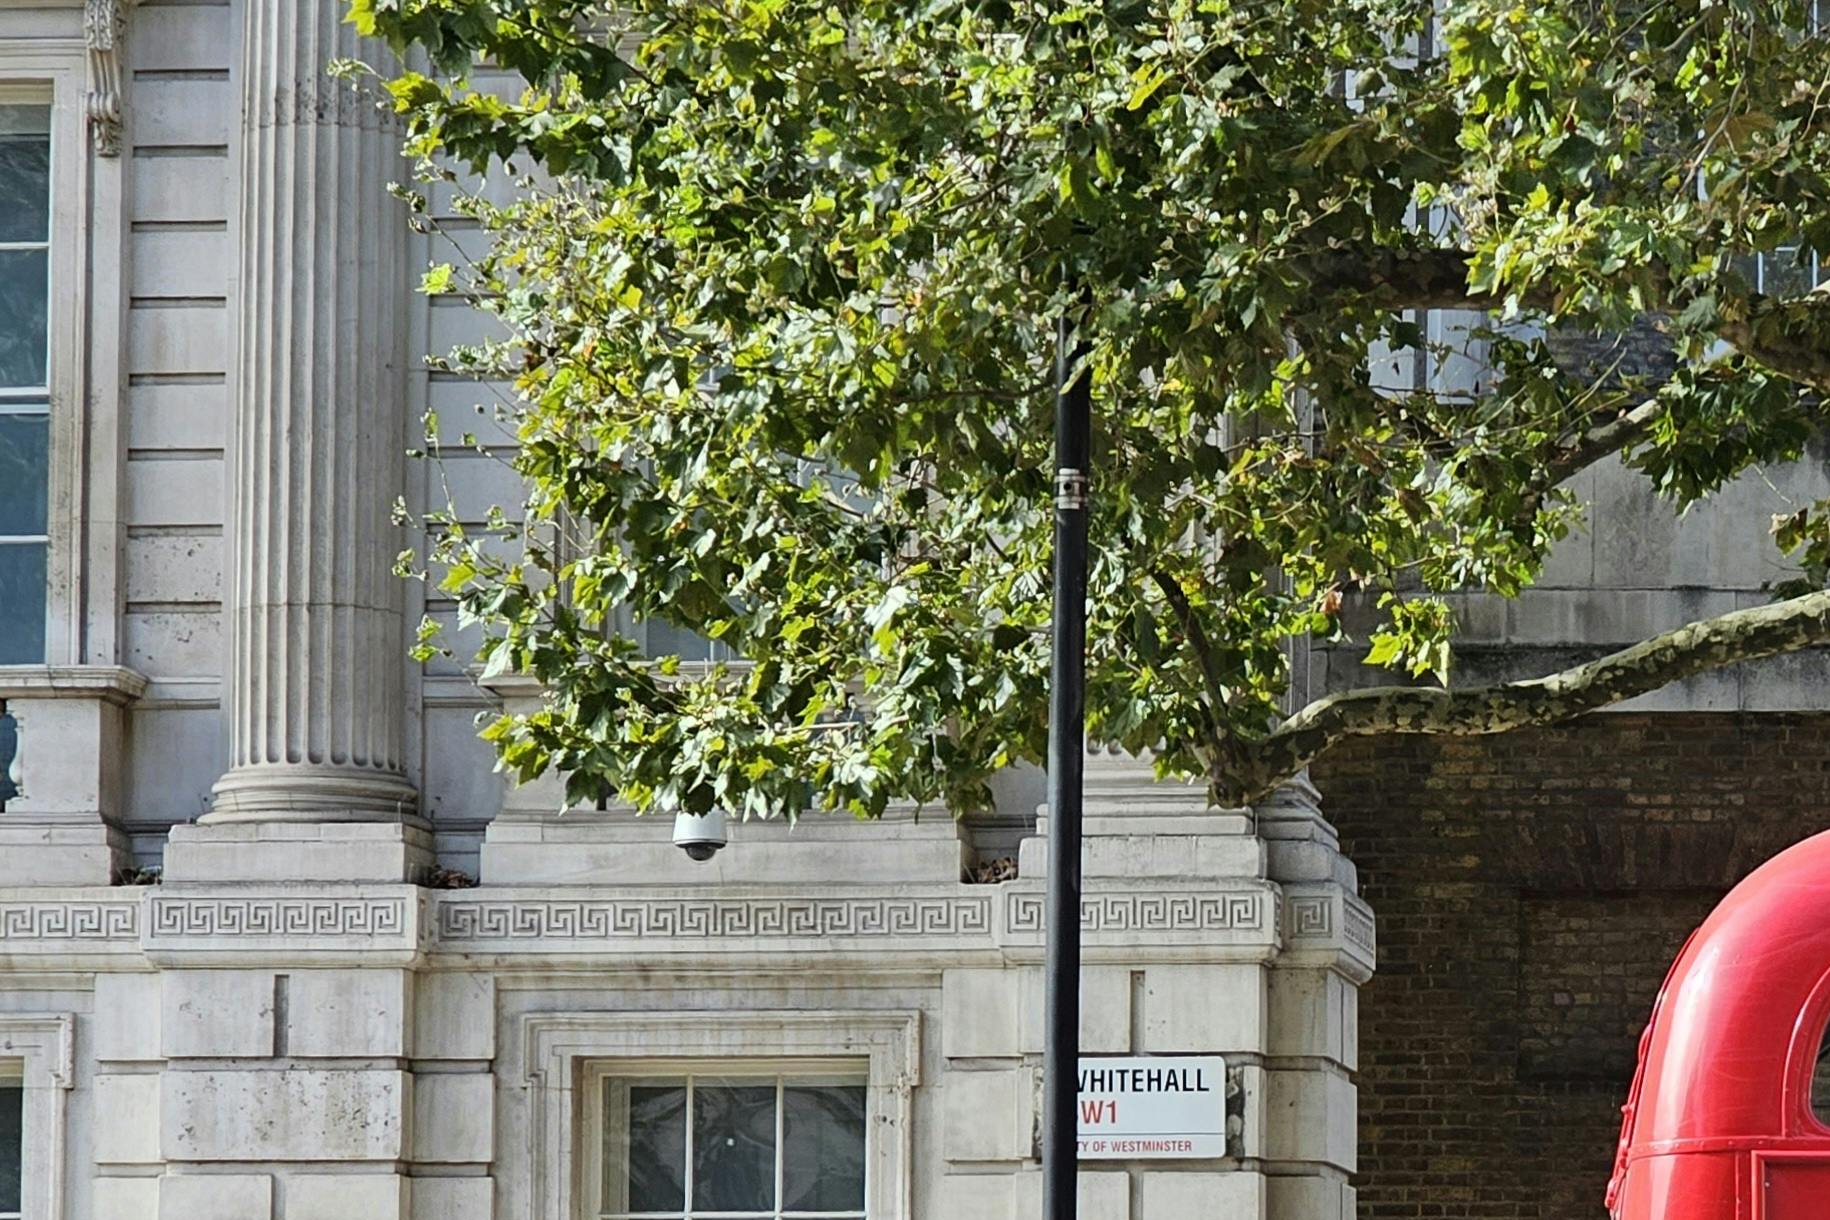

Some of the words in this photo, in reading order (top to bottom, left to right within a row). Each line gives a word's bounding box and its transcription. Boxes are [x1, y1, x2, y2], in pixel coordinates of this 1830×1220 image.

[1077, 1099, 1116, 1124] W1
[1092, 1140, 1107, 1152] OF
[1111, 1140, 1192, 1152] WESTMINSTER
